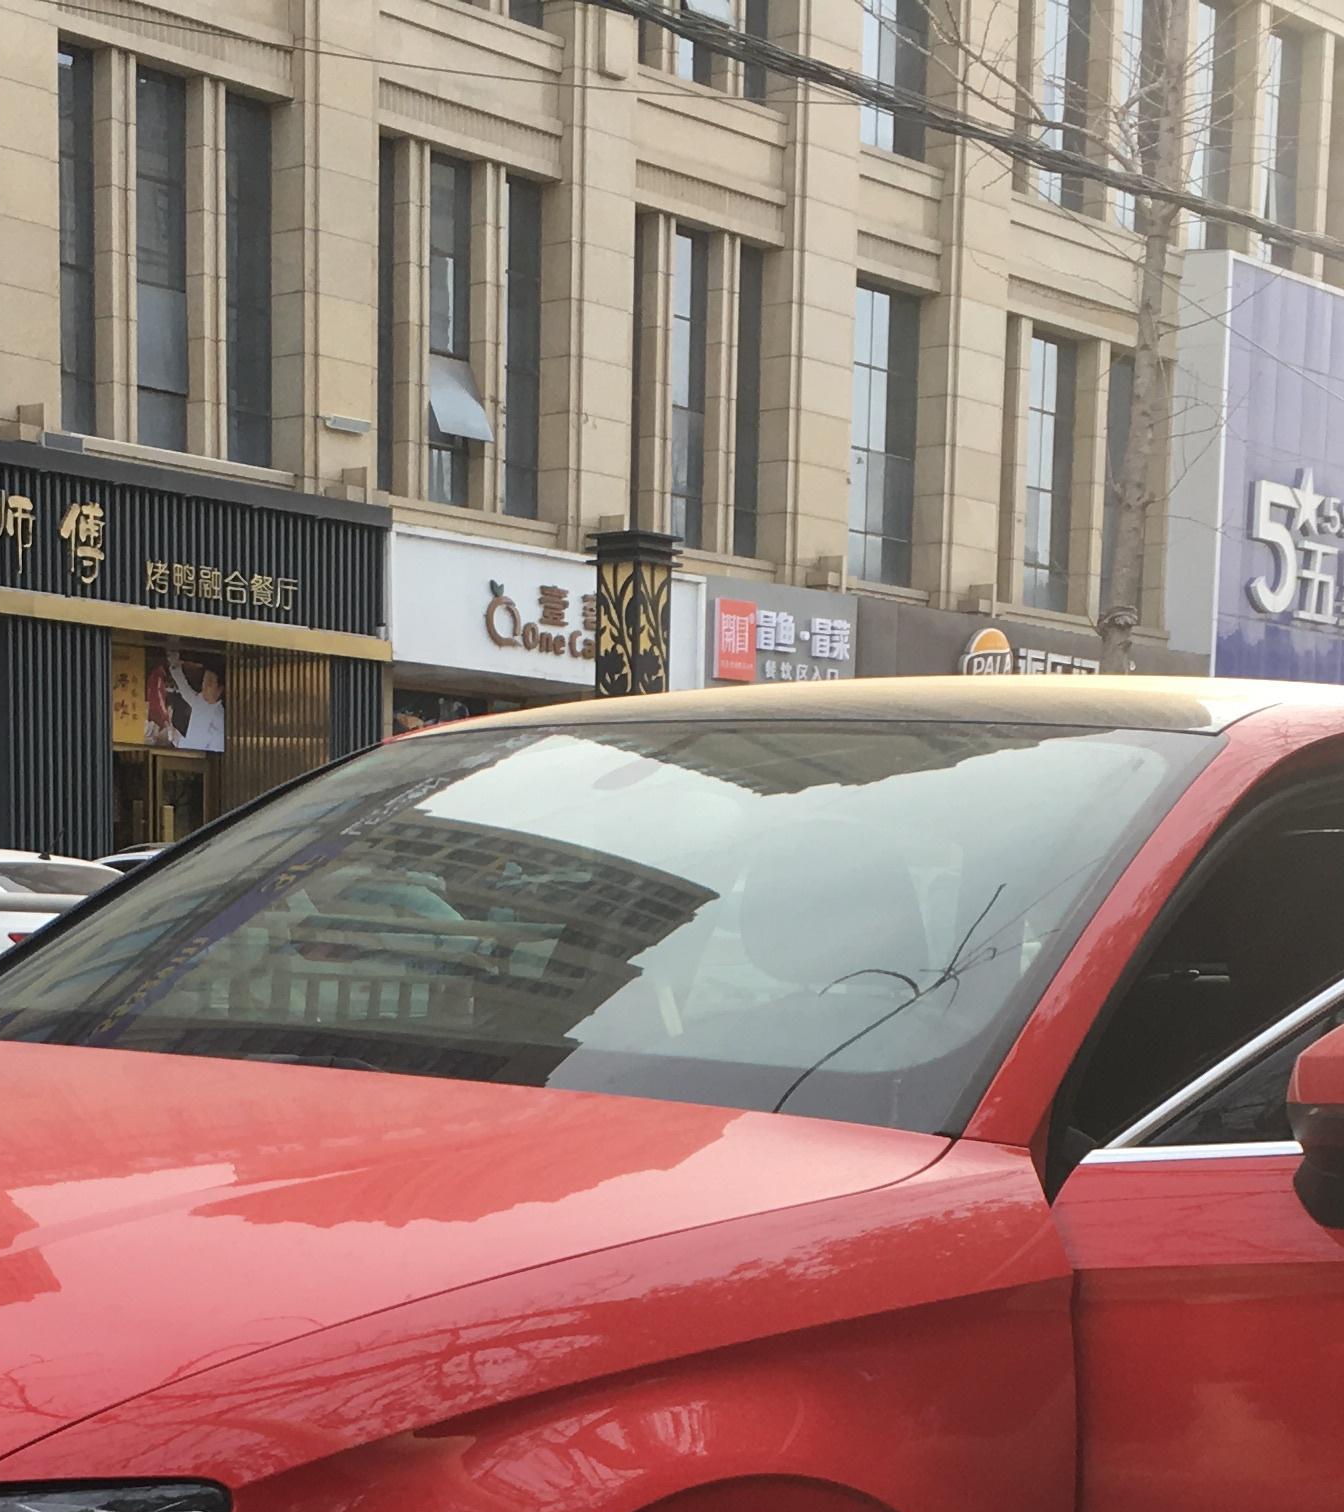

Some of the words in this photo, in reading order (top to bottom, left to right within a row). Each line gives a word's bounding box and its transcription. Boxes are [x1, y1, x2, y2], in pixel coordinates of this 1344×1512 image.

[145, 559, 298, 611] 烤鸭融合餐厅
[522, 622, 566, 656] One
